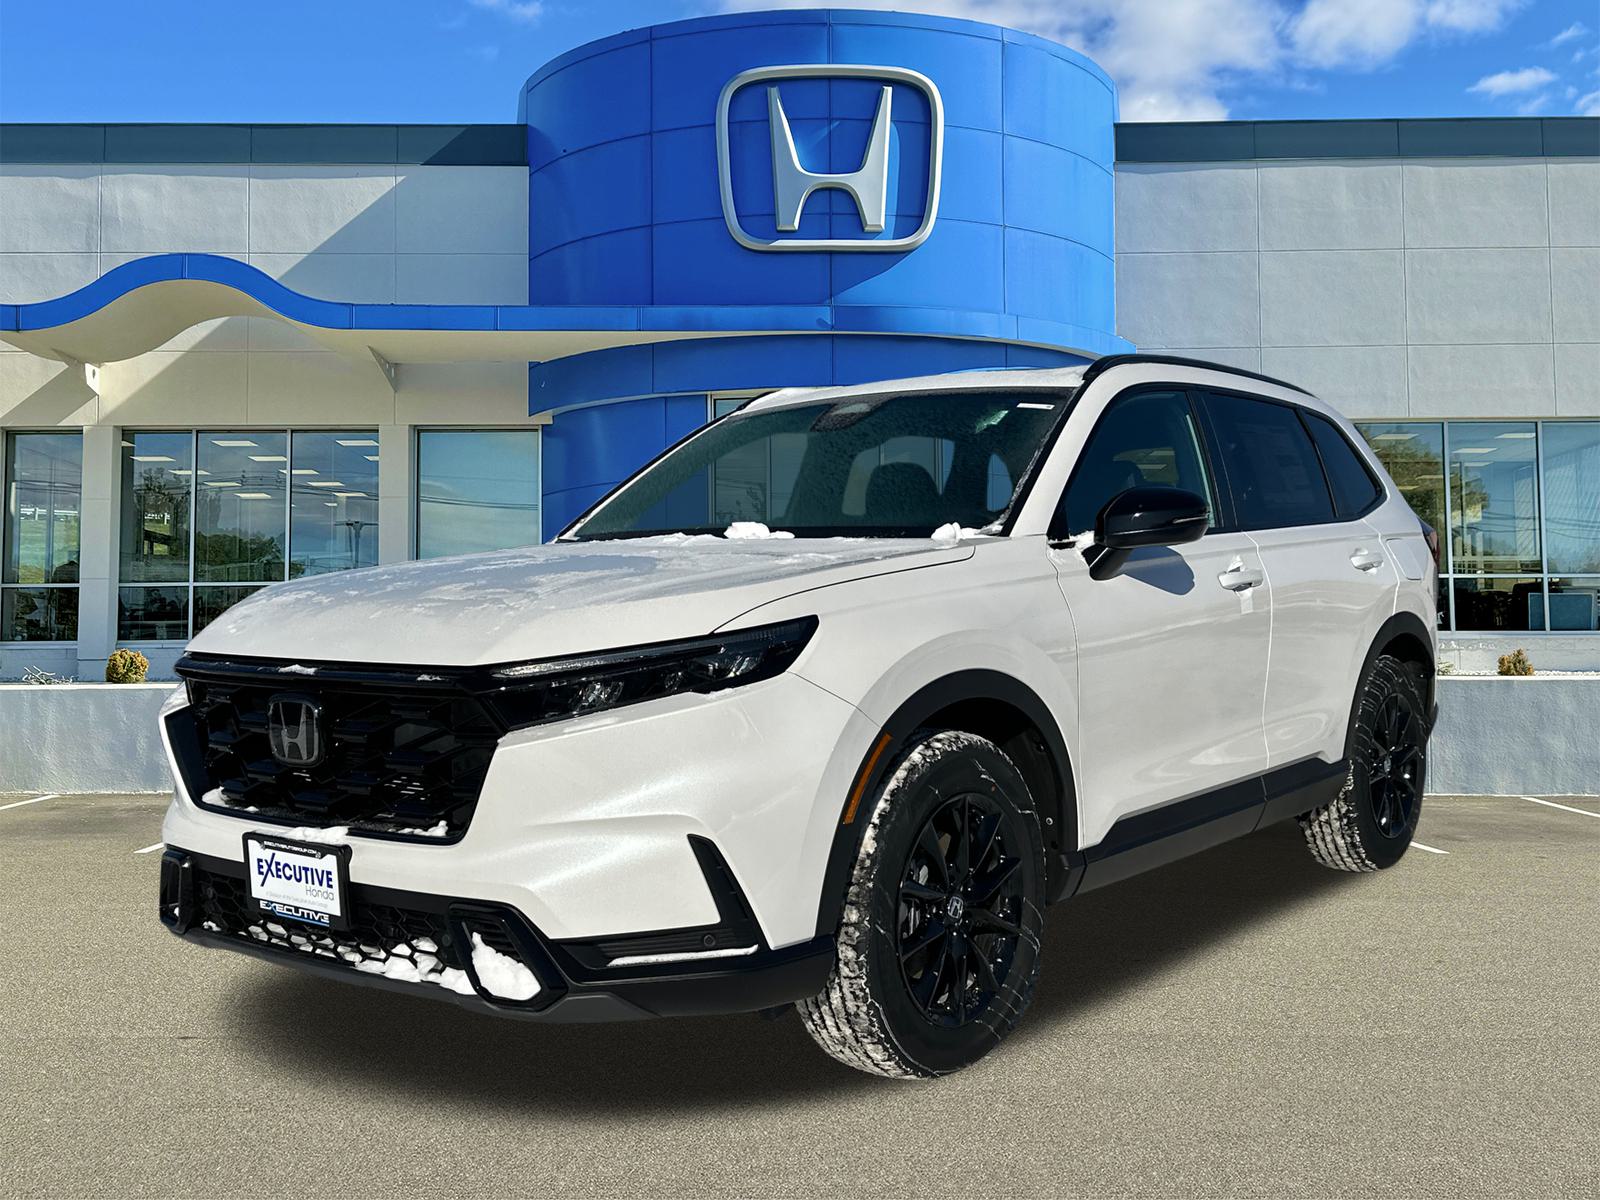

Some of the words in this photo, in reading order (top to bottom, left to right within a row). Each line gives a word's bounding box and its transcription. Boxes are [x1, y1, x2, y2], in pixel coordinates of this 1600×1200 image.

[256, 852, 334, 889] EXECUTIVE
[305, 886, 335, 901] Honda
[260, 900, 330, 924] EXECUTIVE
